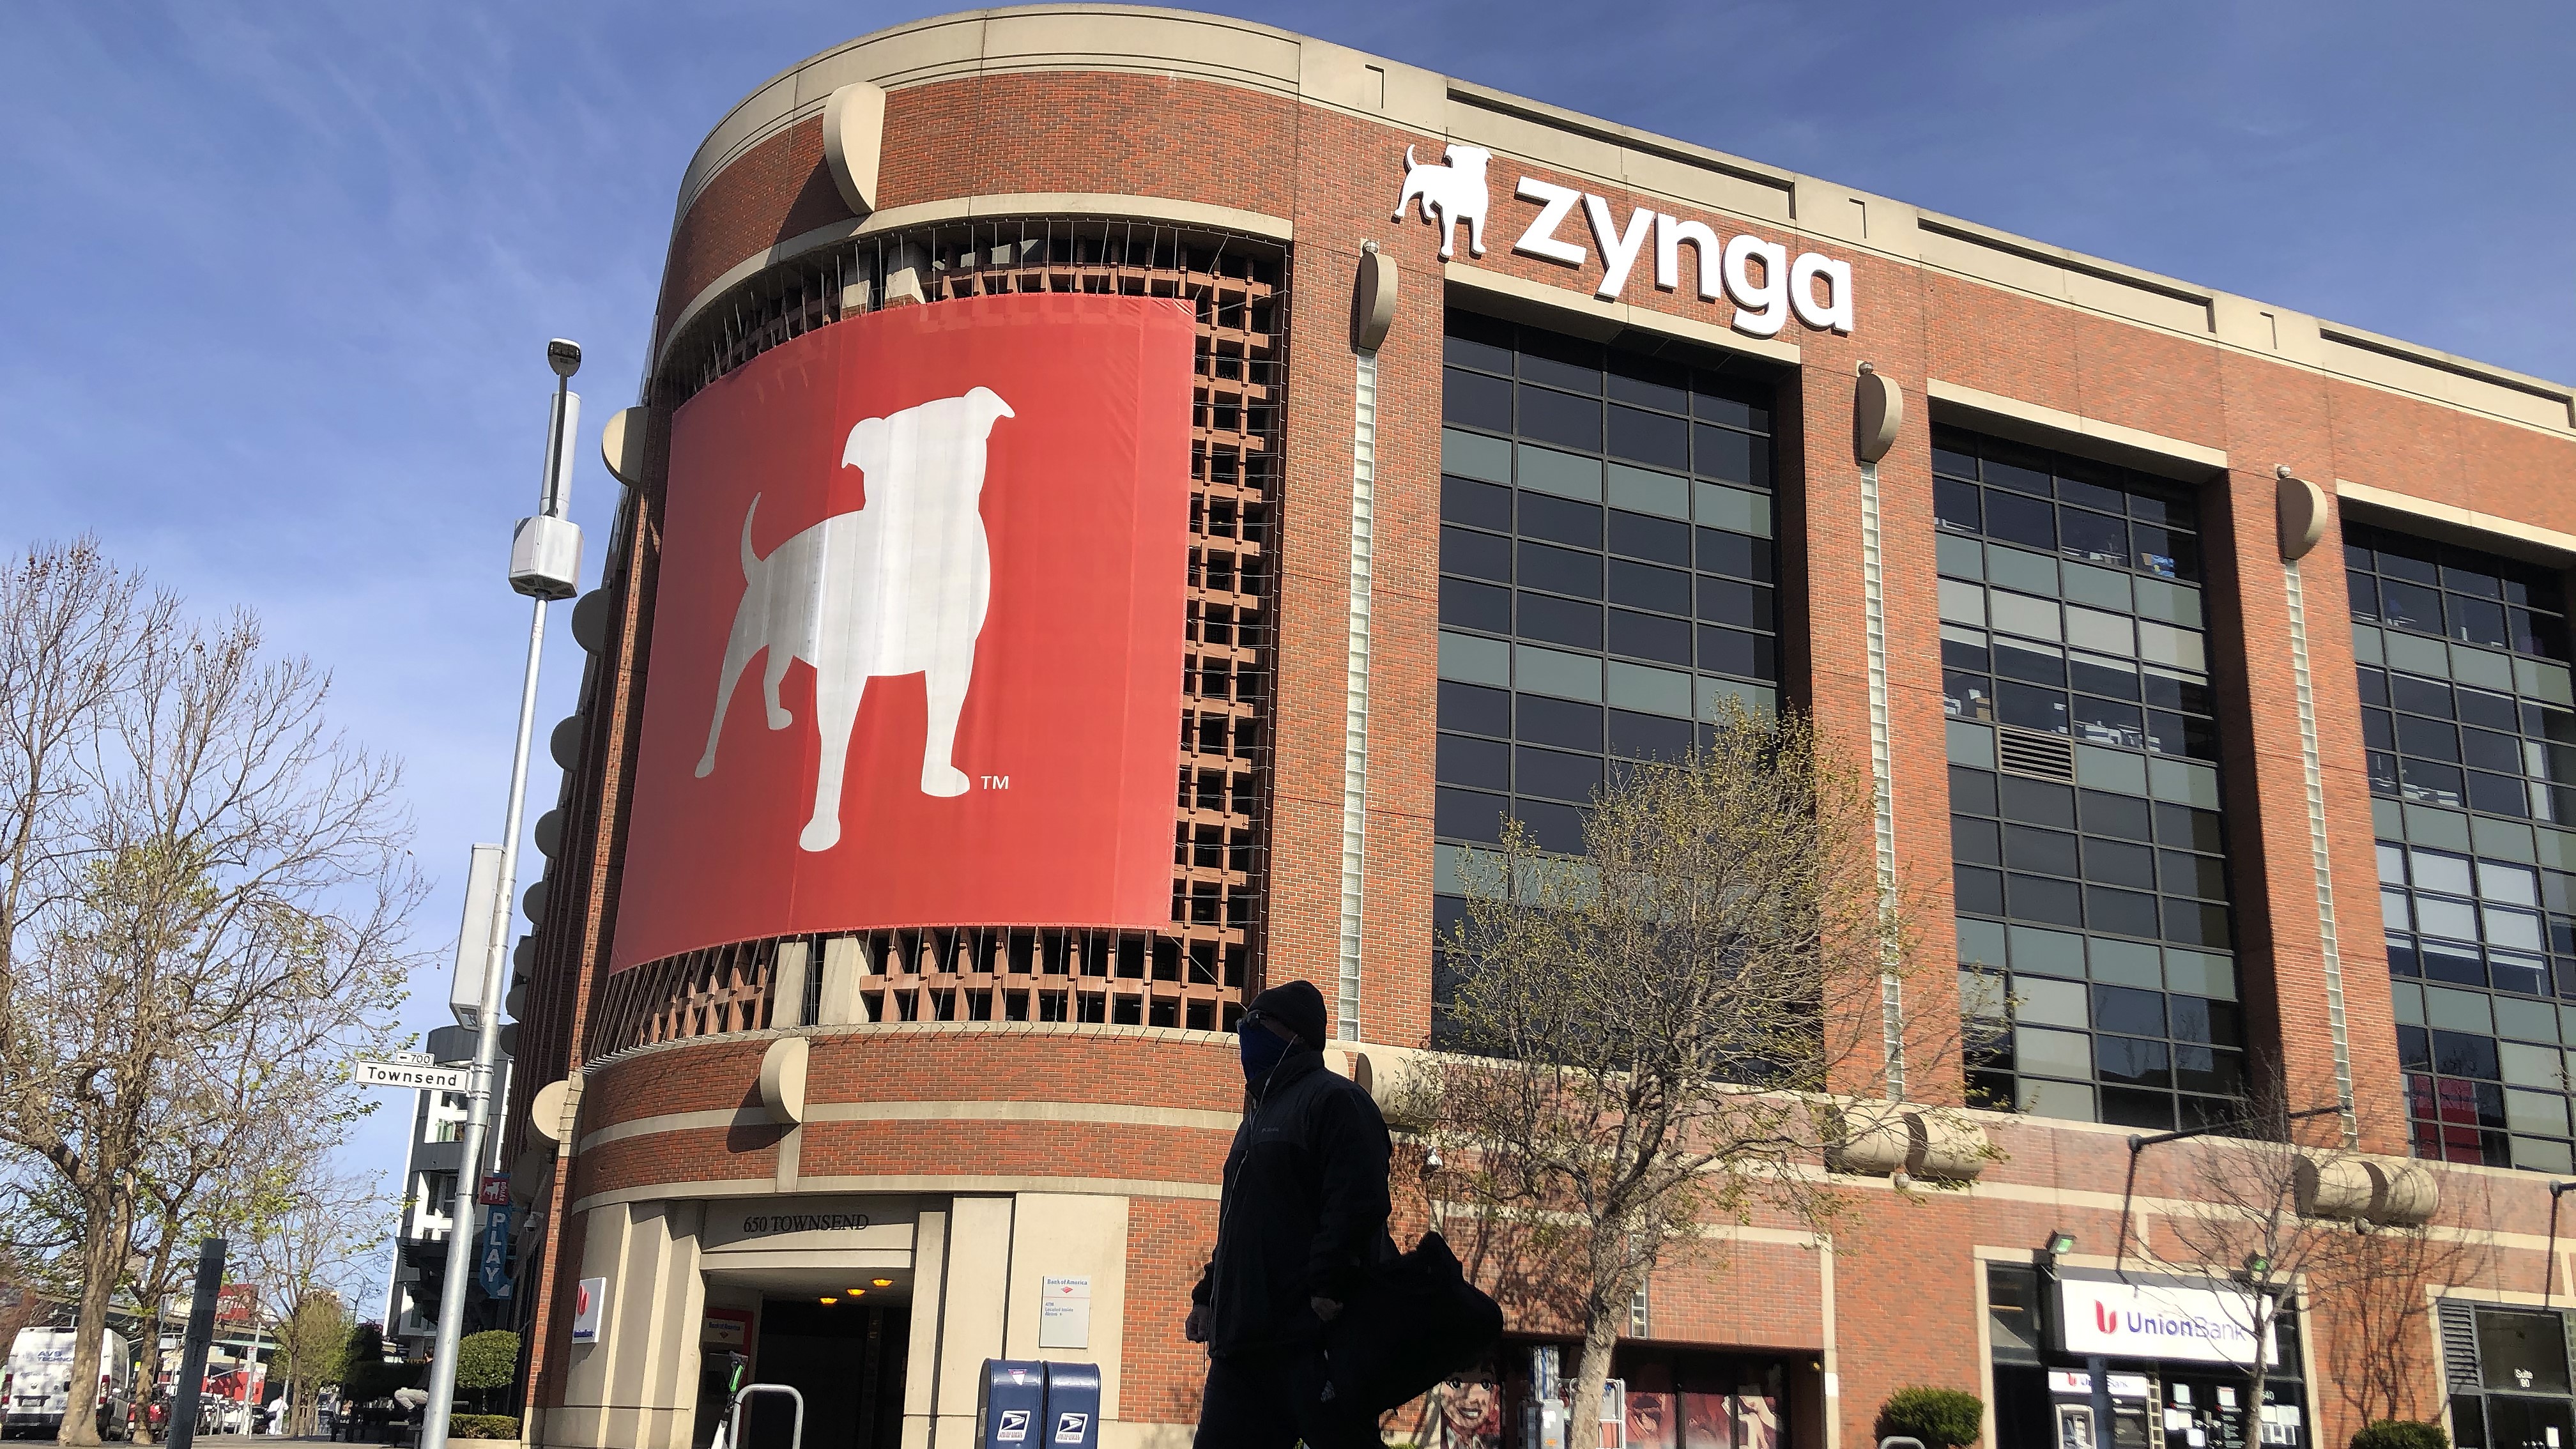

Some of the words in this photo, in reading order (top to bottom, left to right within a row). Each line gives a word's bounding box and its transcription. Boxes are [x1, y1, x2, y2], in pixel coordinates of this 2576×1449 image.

[1514, 175, 1853, 336] zynga
[980, 775, 1009, 790] TM
[411, 1054, 431, 1064] 700
[367, 1066, 457, 1086] Townsend
[743, 1216, 767, 1232] 650
[770, 1214, 870, 1232] TOWNSEND
[485, 1212, 507, 1282] PLAY
[2127, 1311, 2246, 1342] UnionBank
